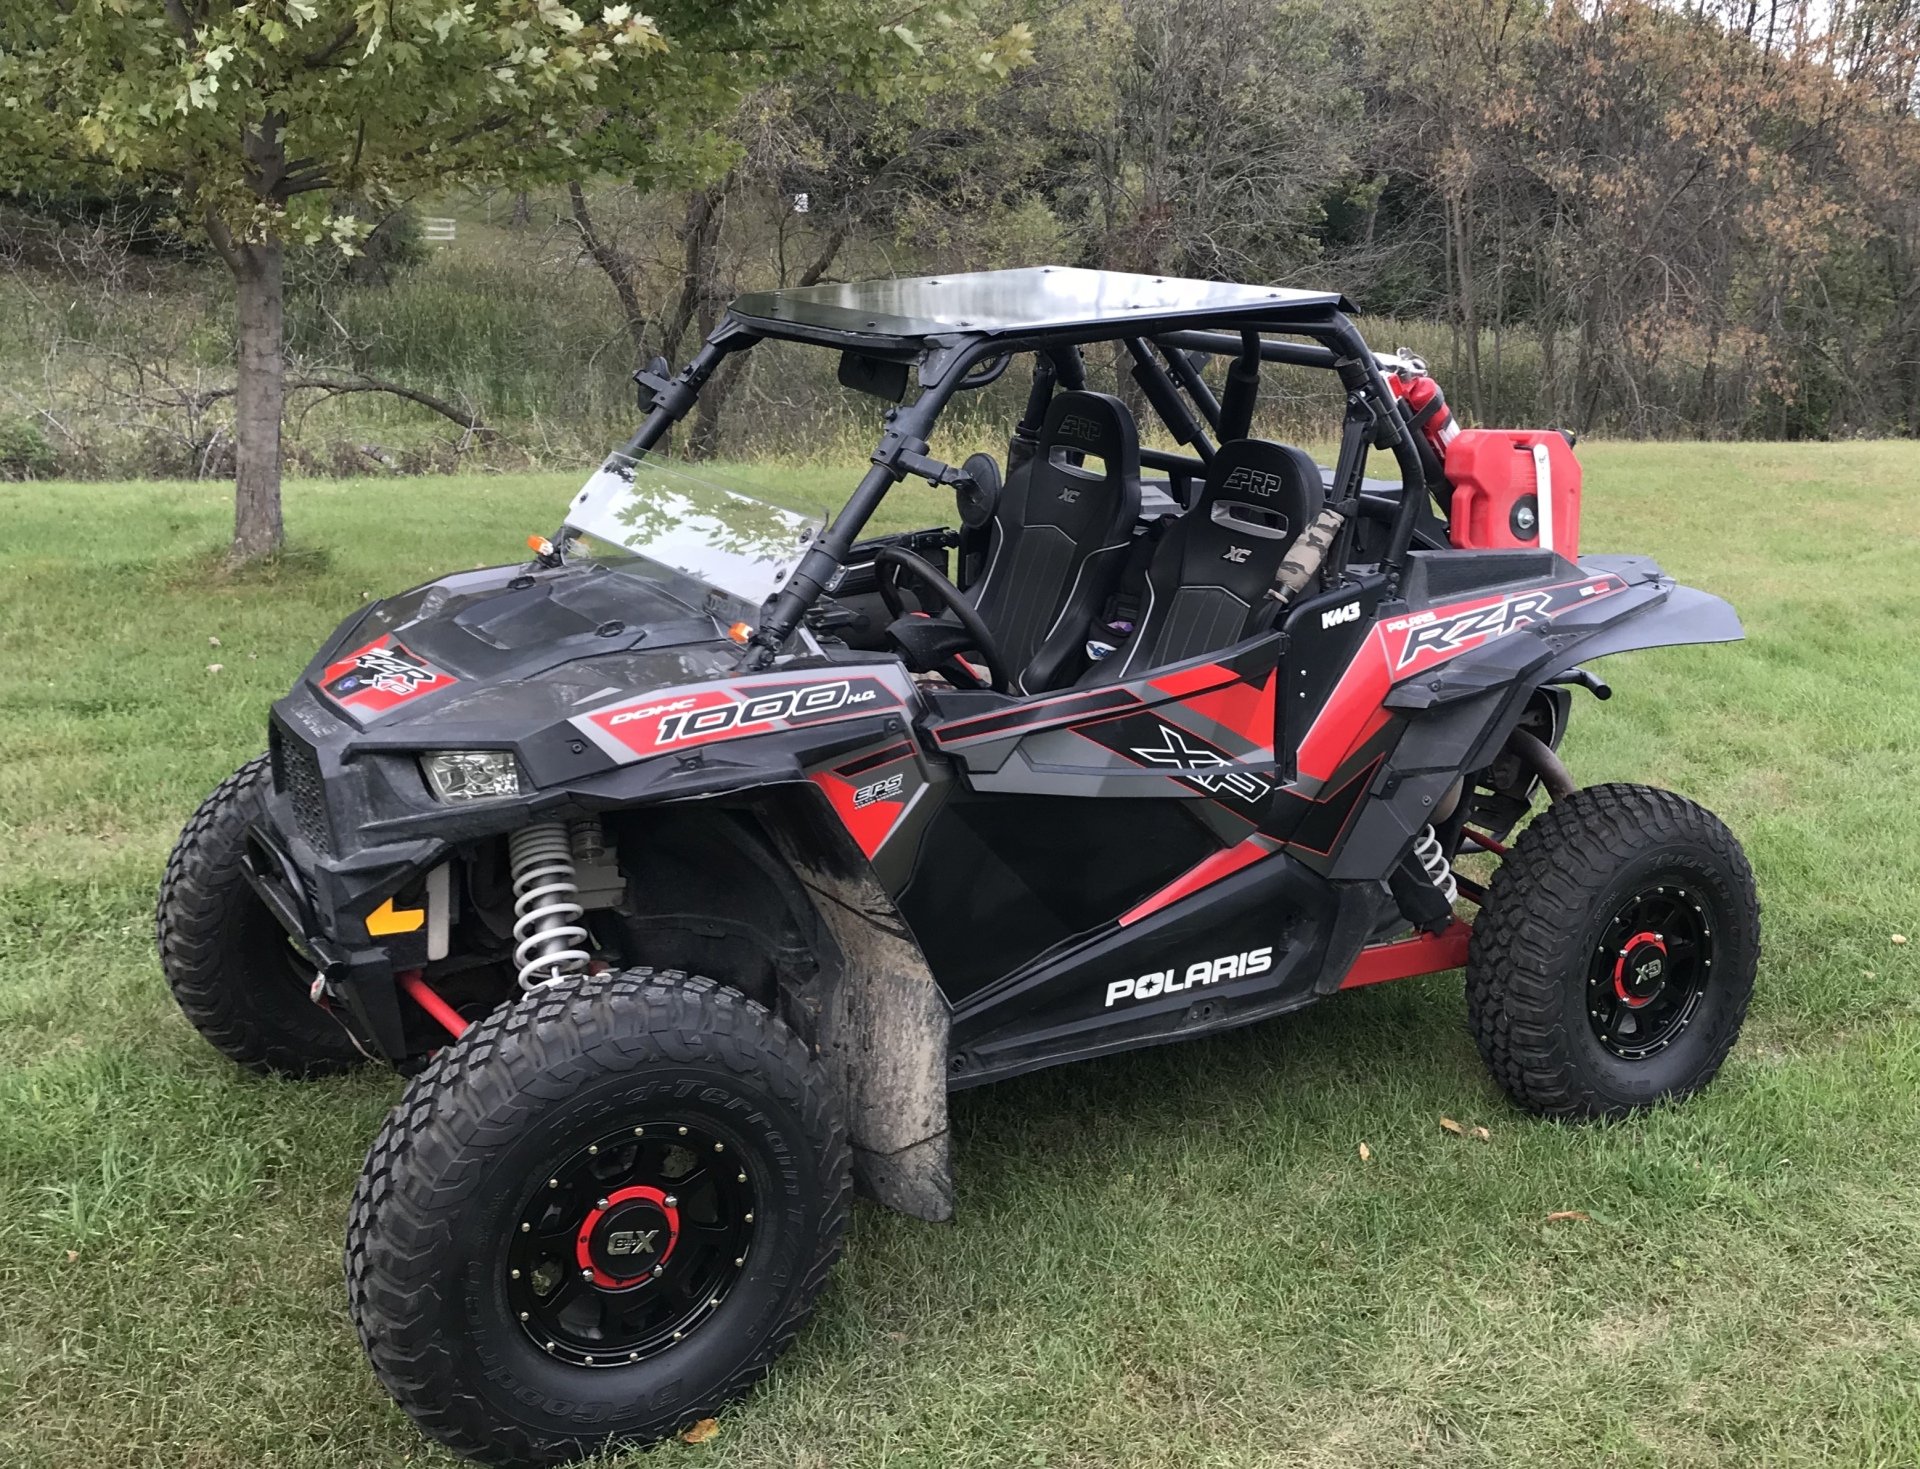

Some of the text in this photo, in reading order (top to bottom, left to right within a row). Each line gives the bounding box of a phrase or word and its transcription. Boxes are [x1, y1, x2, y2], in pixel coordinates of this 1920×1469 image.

[1058, 487, 1082, 503] XC
[1223, 545, 1253, 564] XC
[1386, 611, 1437, 634] POLARIS
[1395, 590, 1553, 672] RZR
[609, 698, 697, 726] DOHC
[654, 680, 851, 746] 1000
[852, 773, 904, 803] EPS
[1104, 946, 1273, 1007] POLARIS
